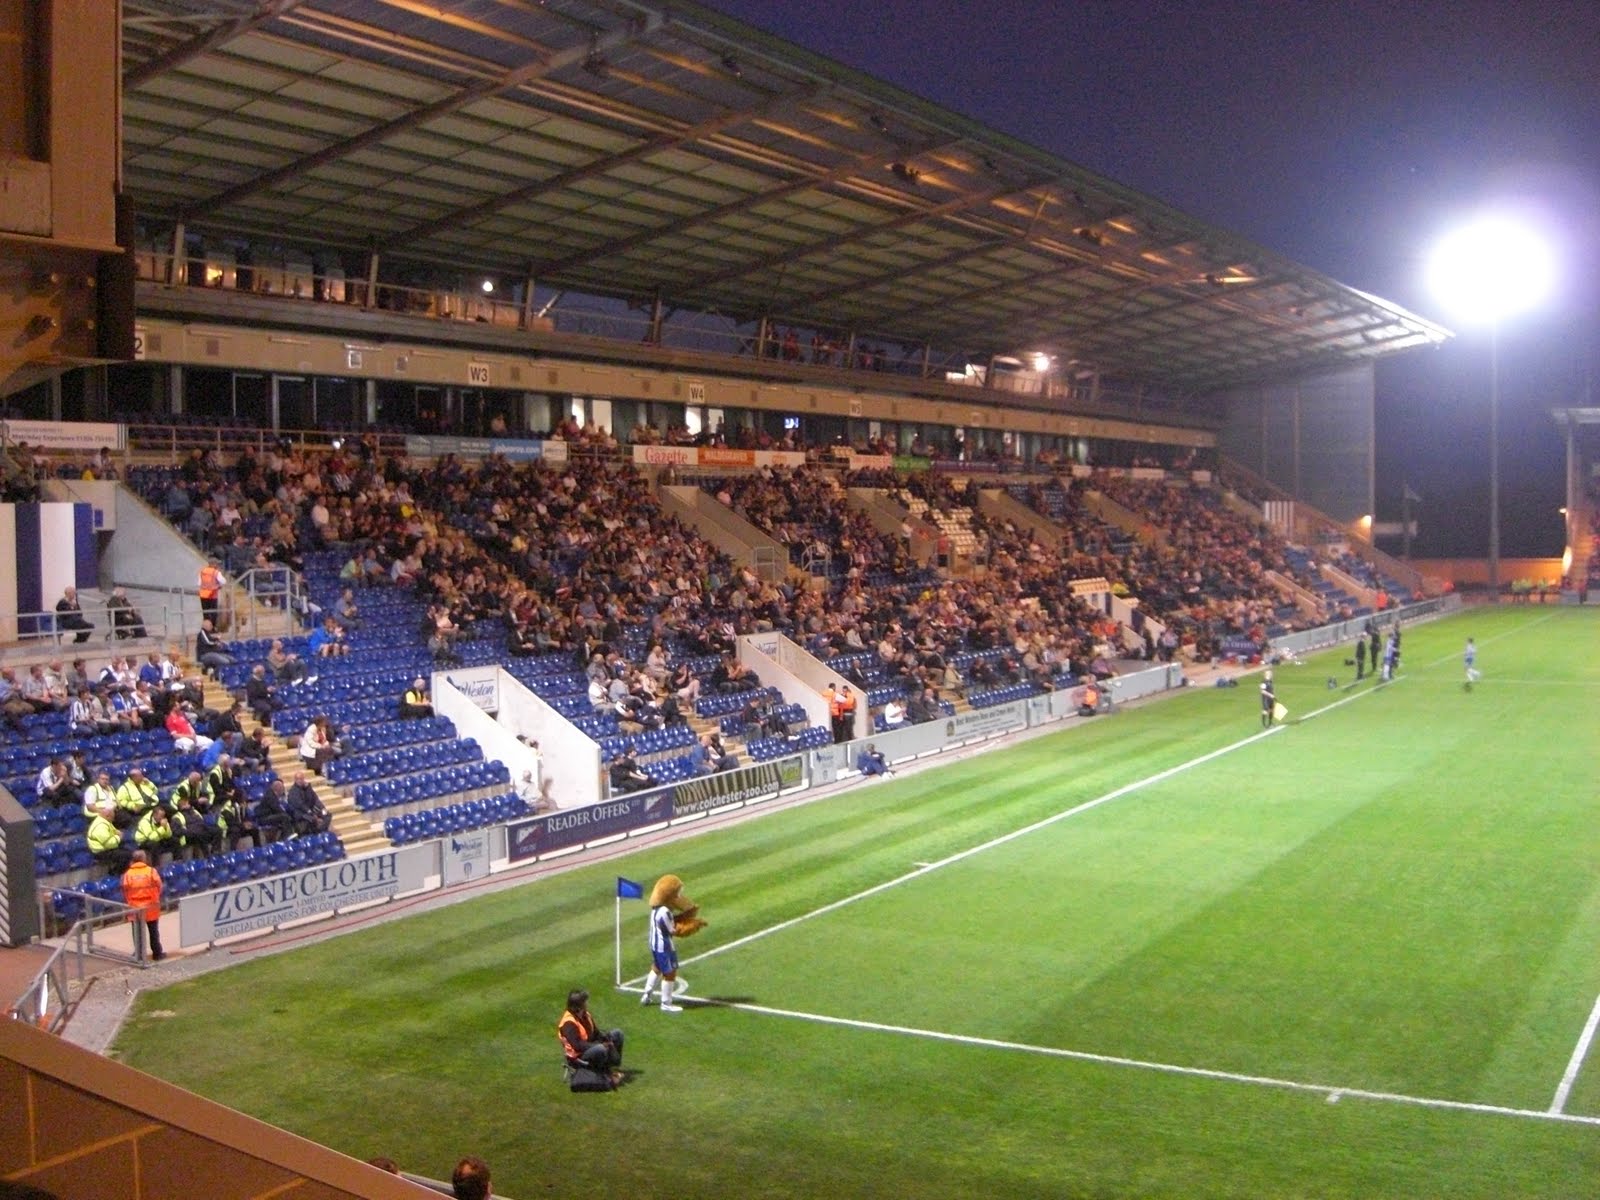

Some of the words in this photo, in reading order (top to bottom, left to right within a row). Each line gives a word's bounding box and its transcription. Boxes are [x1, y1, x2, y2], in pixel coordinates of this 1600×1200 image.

[470, 366, 488, 382] W3
[690, 387, 704, 400] W4
[645, 447, 688, 464] Gazette
[674, 780, 780, 816] www.colchester-zoo.com
[547, 812, 591, 833] READER
[592, 801, 631, 821] OFFERS
[213, 852, 400, 922] ZONECLOTH
[214, 920, 255, 938] OFFICIAL
[256, 910, 300, 928] CLEANERS
[301, 905, 317, 918] FOR
[318, 894, 369, 913] COLCHESTER
